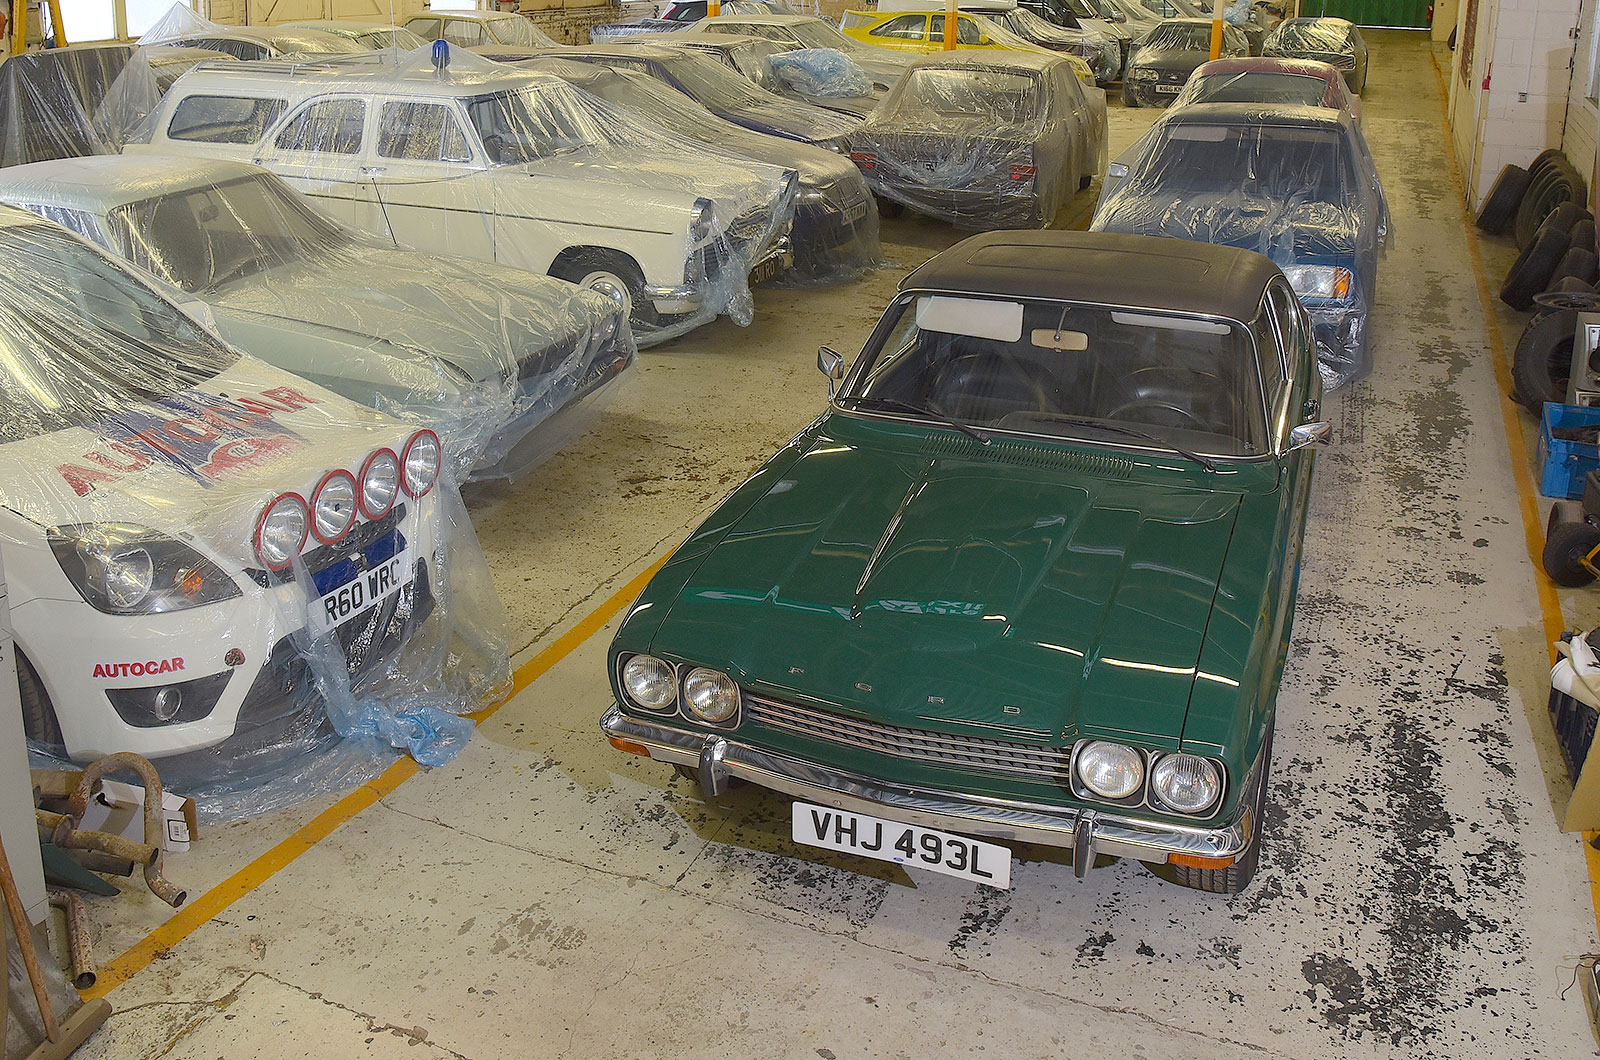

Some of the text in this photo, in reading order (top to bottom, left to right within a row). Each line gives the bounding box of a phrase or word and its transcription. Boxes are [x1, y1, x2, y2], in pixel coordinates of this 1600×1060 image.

[324, 559, 399, 621] R60 WRC
[92, 656, 185, 678] AUTOCAR
[810, 809, 993, 879] VHJ 493L
